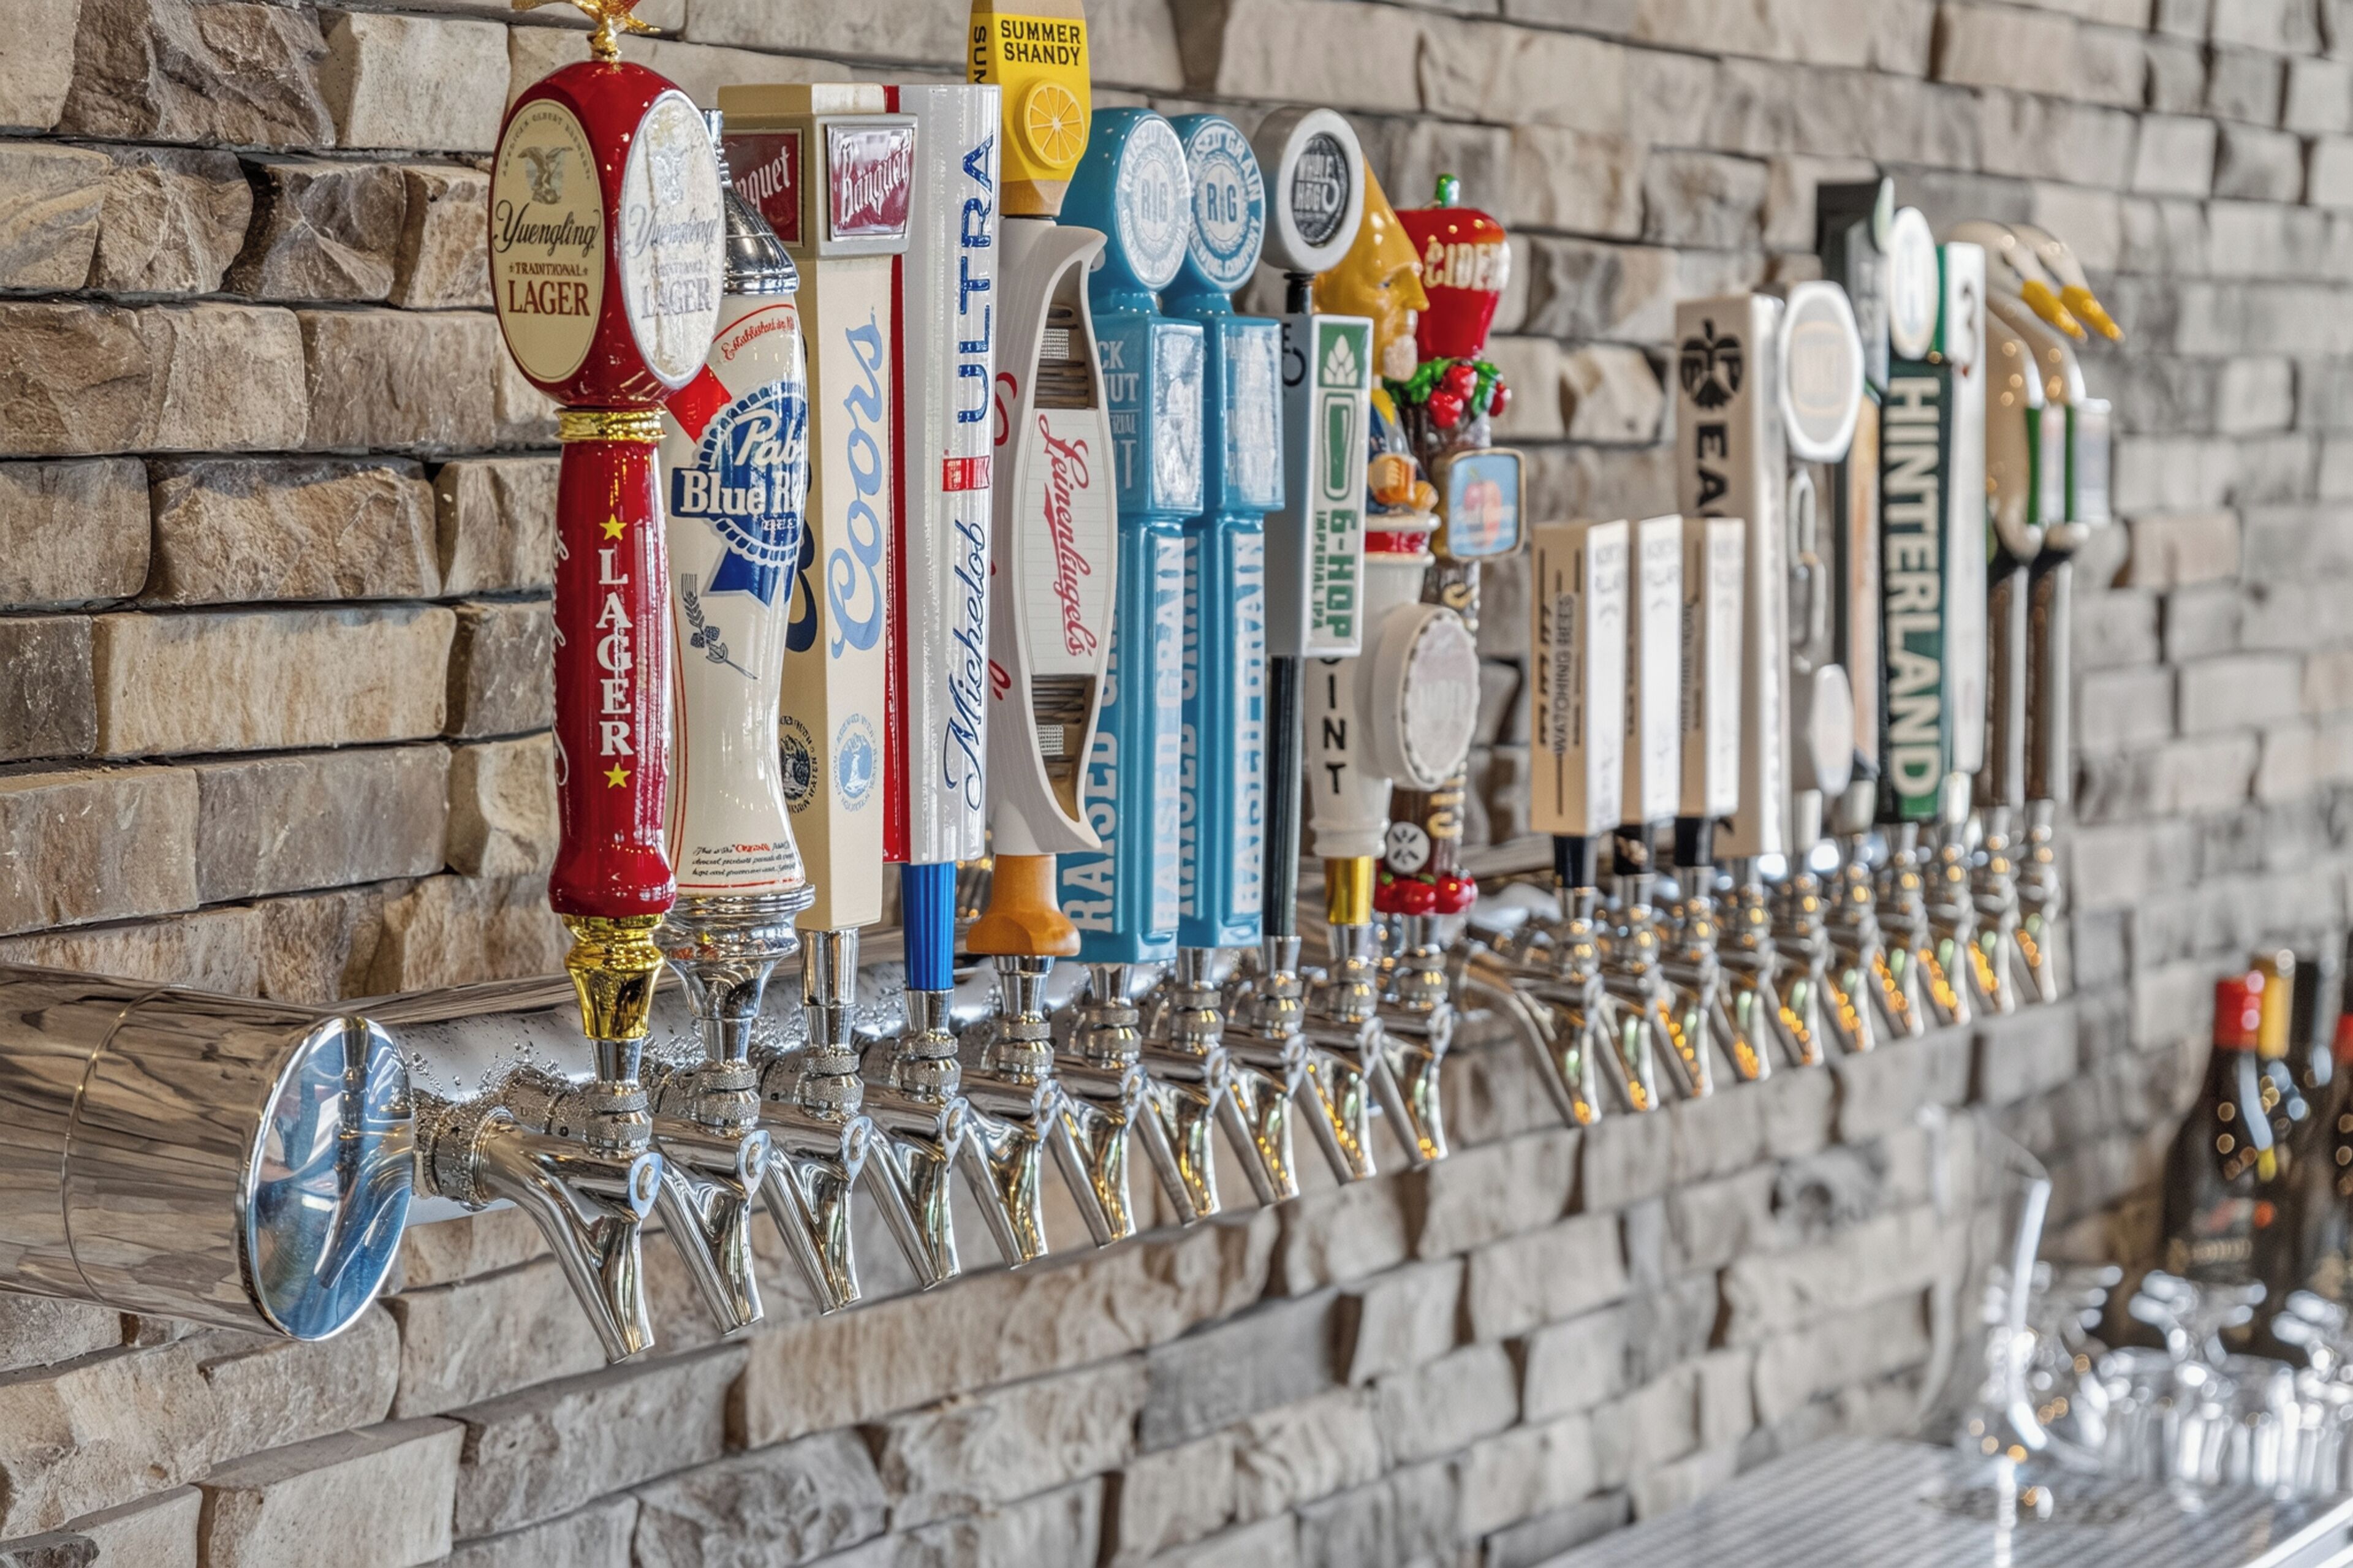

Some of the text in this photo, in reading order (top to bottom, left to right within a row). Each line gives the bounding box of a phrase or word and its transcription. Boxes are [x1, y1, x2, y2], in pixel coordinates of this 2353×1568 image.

[974, 26, 987, 84] SUM
[1001, 20, 1081, 44] SUMMER
[1004, 42, 1080, 66] SHANDY
[733, 145, 791, 214] nquet
[839, 131, 912, 227] Banquet
[1224, 129, 1261, 202] GRAIN
[493, 199, 601, 258] Yuengling
[516, 262, 582, 276] TRADITIONAL
[958, 131, 994, 423] ULTRA
[508, 279, 590, 316] LAGER
[642, 277, 712, 319] LAGER
[734, 407, 804, 466] Pab
[828, 306, 883, 659] Coors
[680, 470, 766, 517] Blue
[1038, 413, 1097, 657] Leinenkugel's
[1311, 511, 1327, 630] IMPERIAL IPA
[1325, 509, 1357, 638] 6-HOP
[1882, 376, 1942, 798] HINTERLAND
[596, 549, 634, 756] LAGER
[944, 518, 986, 811] Michelob
[1154, 537, 1184, 930] RAISED GRAIN
[1233, 532, 1264, 912] RAISED GRAIN
[1319, 658, 1346, 793] INT
[1062, 732, 1117, 933] RASED
